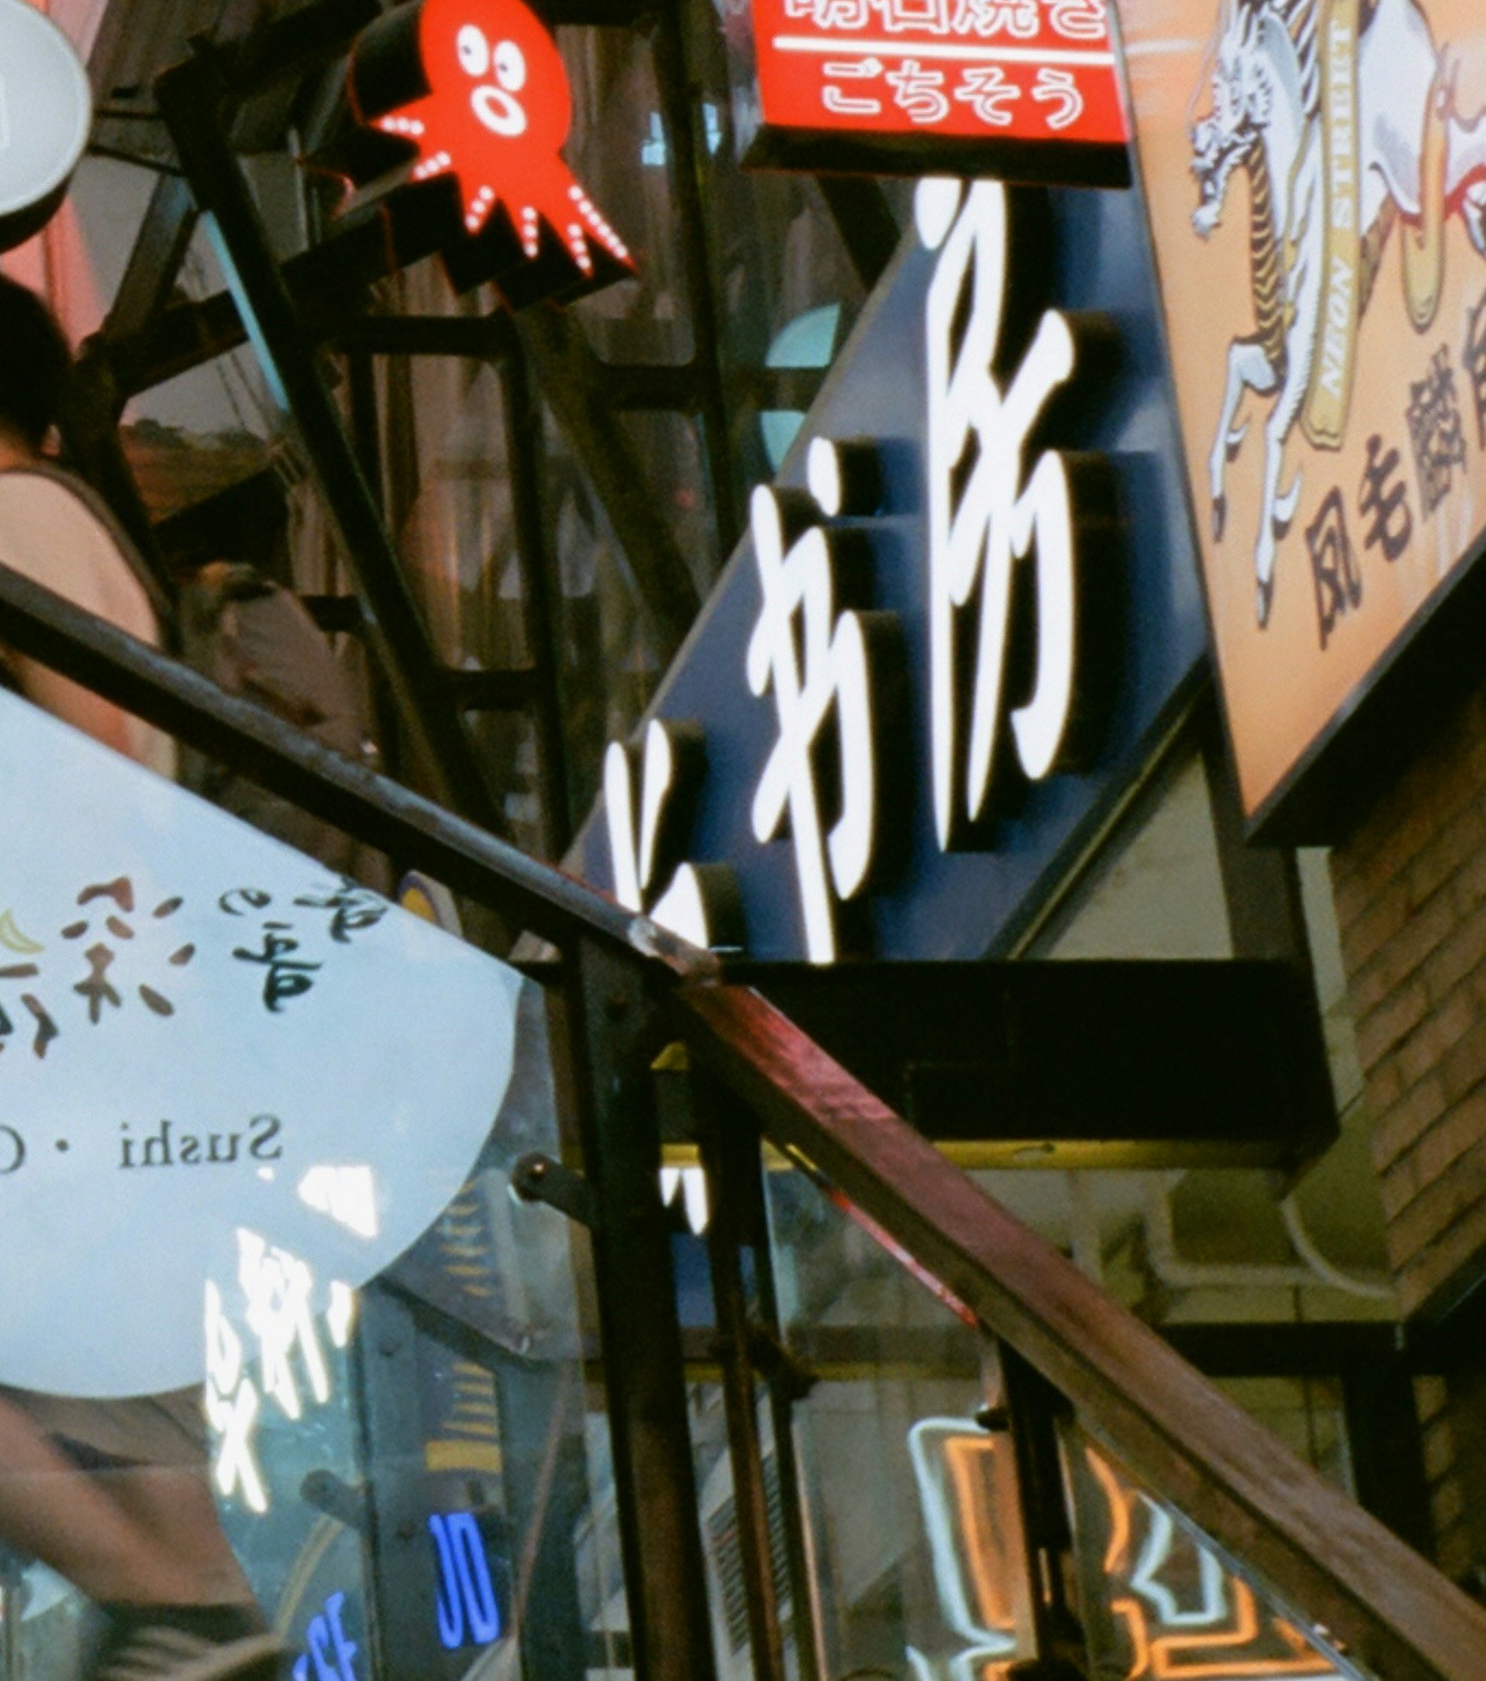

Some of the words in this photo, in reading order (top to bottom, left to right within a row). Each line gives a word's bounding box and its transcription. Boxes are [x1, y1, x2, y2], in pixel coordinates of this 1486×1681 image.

[821, 57, 1085, 130] ごちそう
[1326, 17, 1356, 227] STREET
[1320, 255, 1353, 404] NEON
